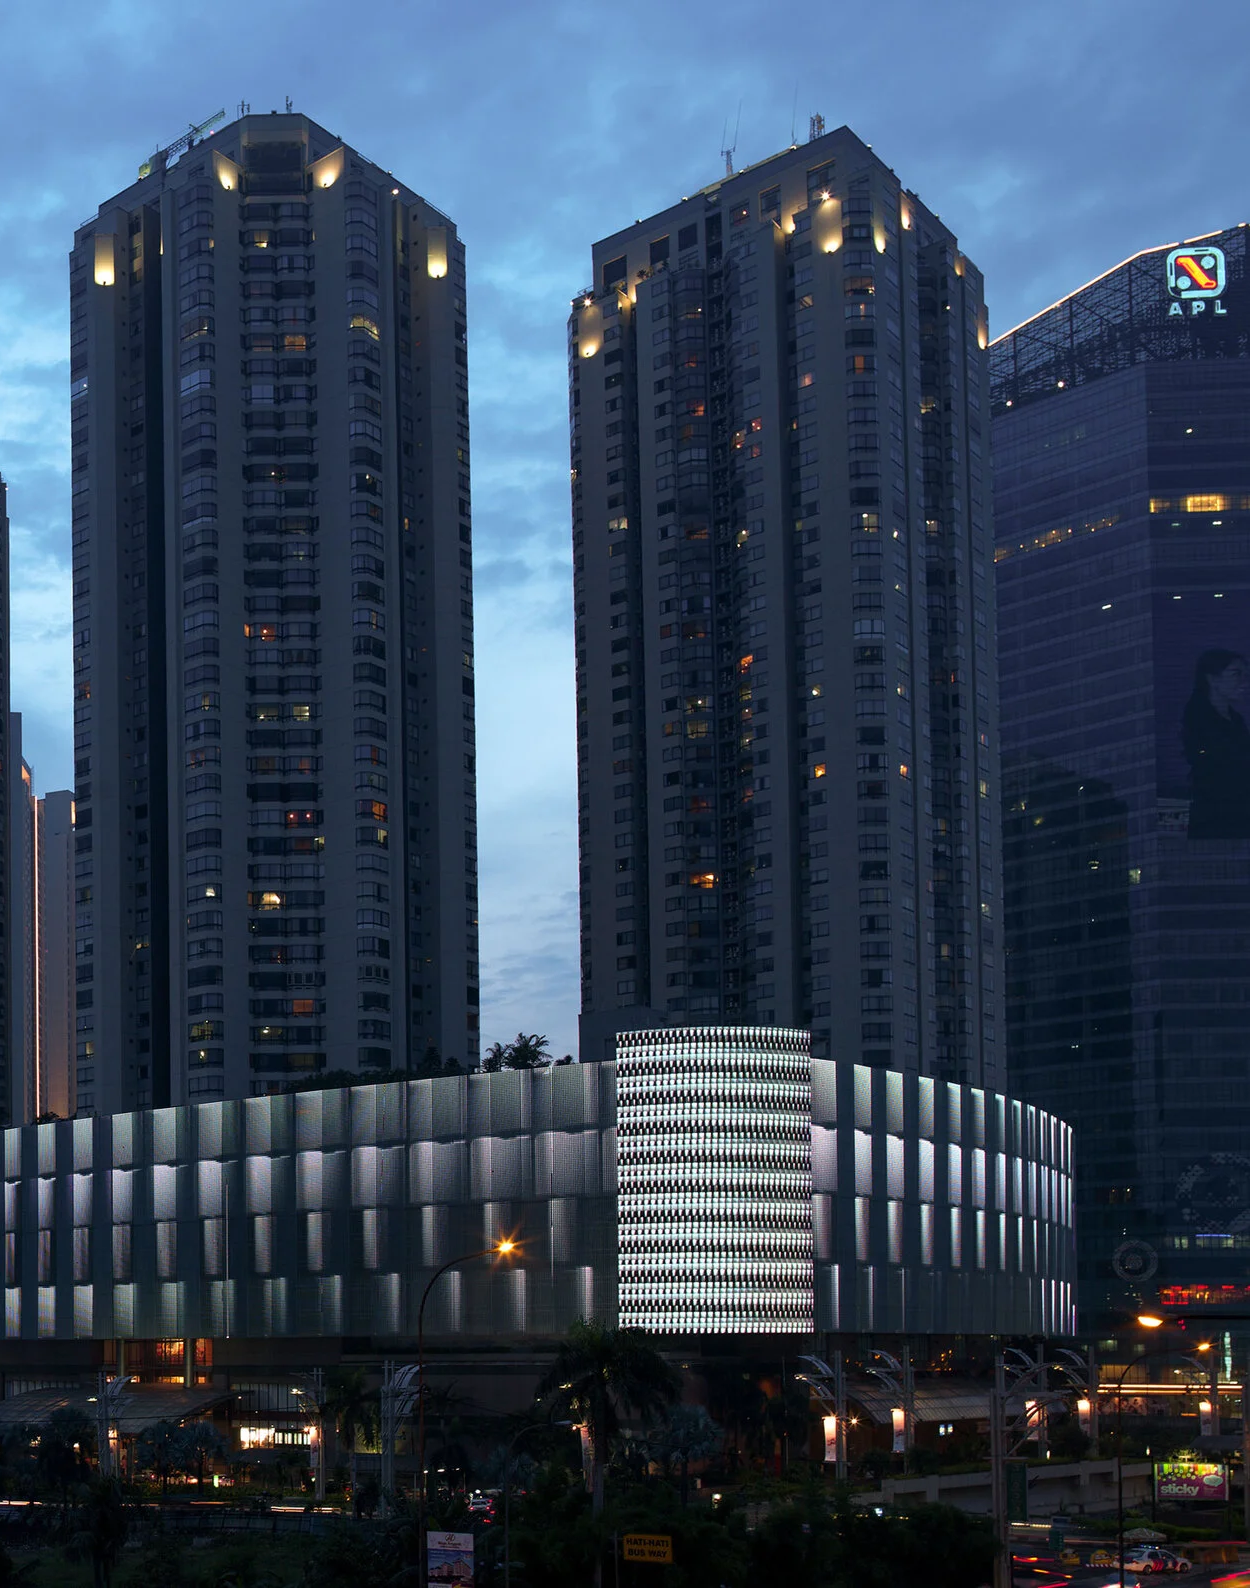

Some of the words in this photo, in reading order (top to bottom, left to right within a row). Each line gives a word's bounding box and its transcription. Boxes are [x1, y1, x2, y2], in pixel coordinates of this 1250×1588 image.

[1169, 300, 1227, 316] APL
[1160, 1483, 1200, 1496] sticky
[626, 1537, 669, 1548] HATI-HATI
[628, 1548, 646, 1557] BUS
[649, 1549, 668, 1558] WAY
